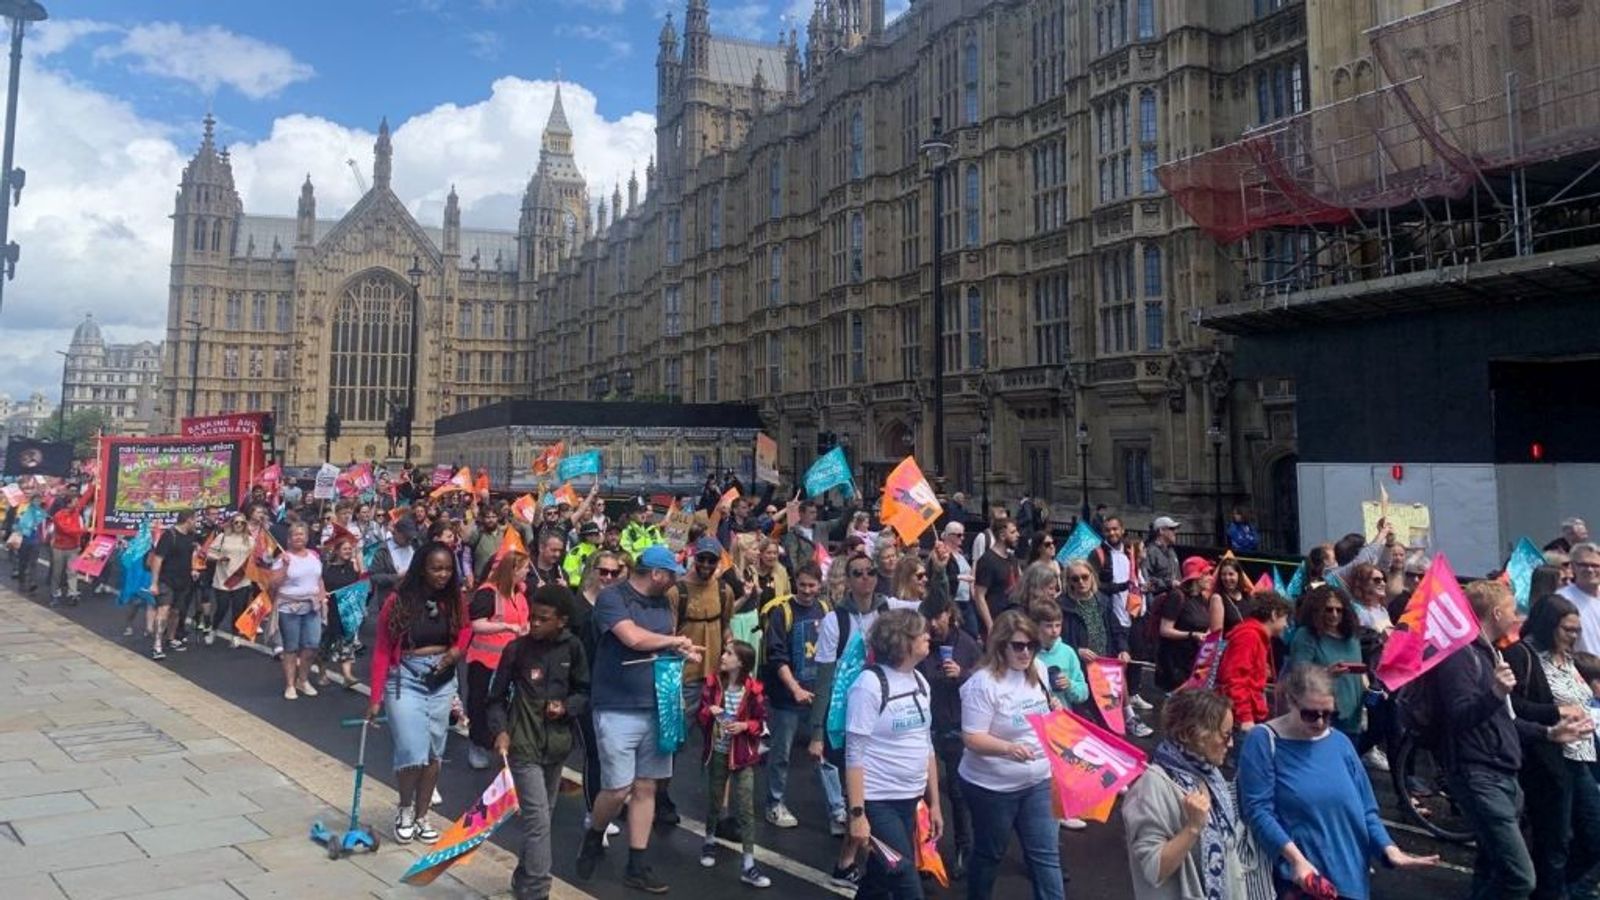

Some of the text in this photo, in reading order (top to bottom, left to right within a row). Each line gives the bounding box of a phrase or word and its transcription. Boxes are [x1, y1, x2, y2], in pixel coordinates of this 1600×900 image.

[187, 419, 230, 434] BARKING
[118, 441, 234, 453] national education union
[124, 455, 225, 472] WALTHAM FOREST
